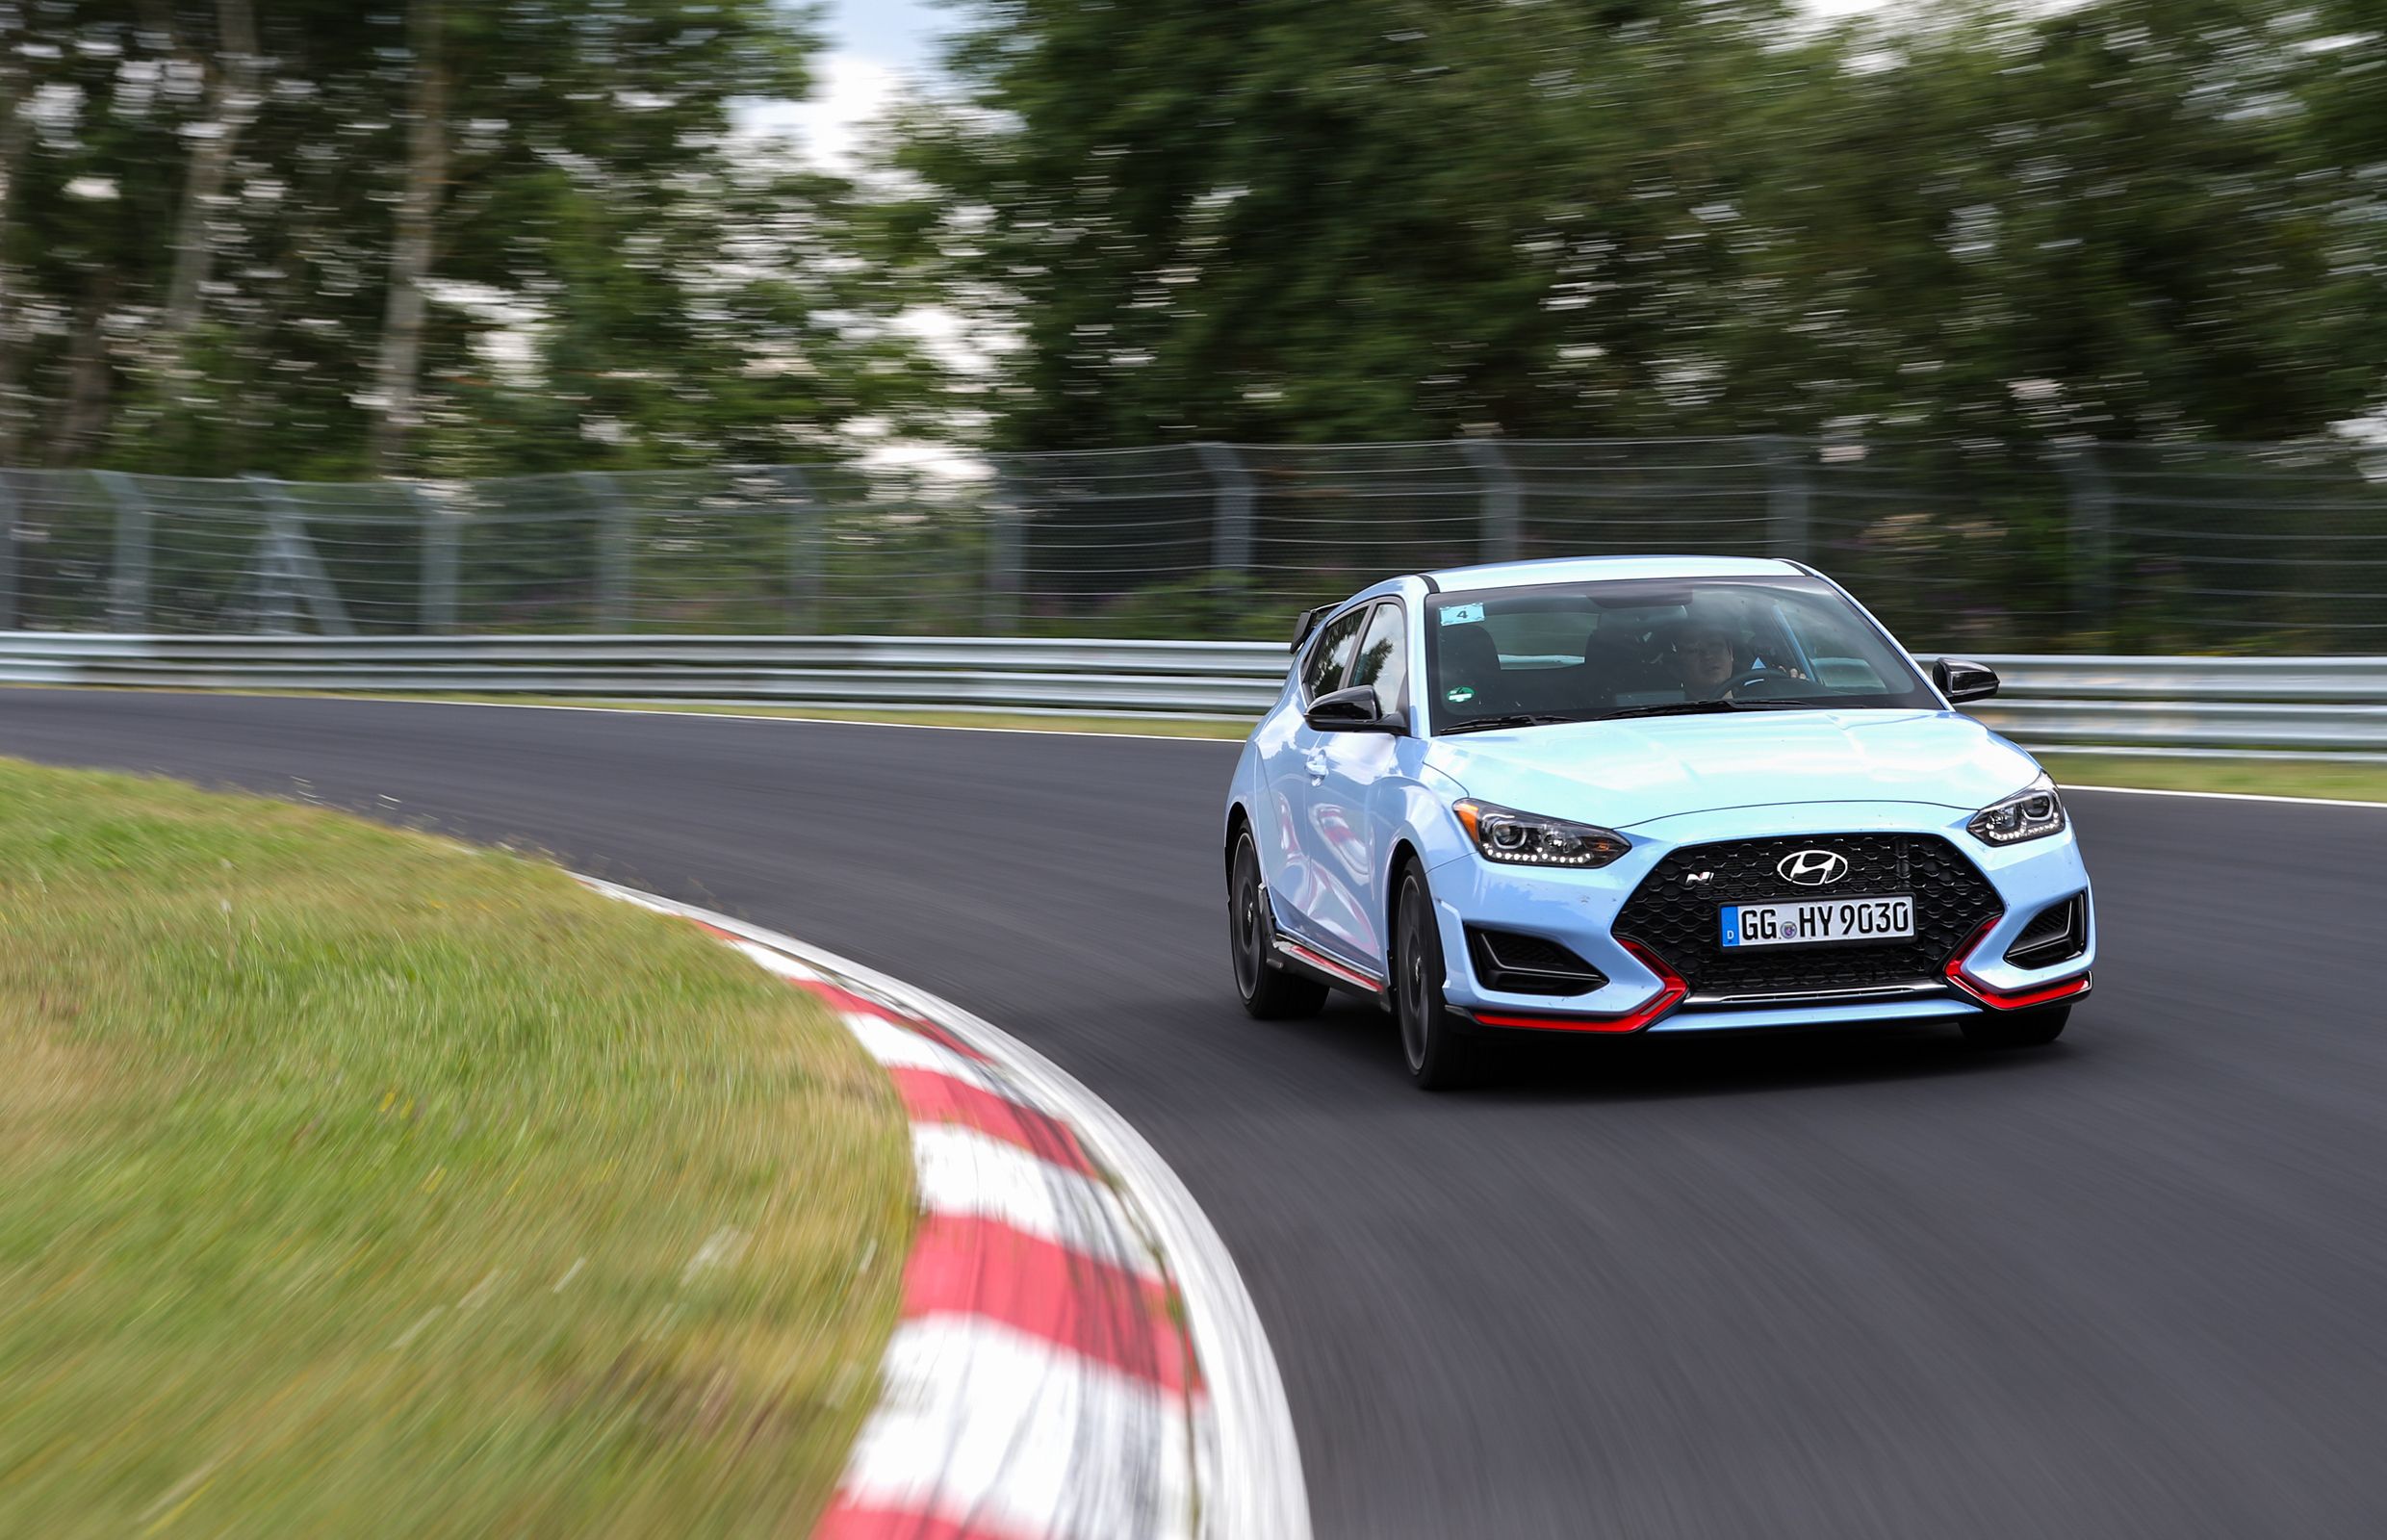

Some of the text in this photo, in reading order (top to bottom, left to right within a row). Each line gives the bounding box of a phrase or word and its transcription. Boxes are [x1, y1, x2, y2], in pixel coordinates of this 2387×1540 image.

[1456, 610, 1469, 619] 4
[1741, 902, 1909, 940] GG HY 9030
[1727, 930, 1734, 939] D
